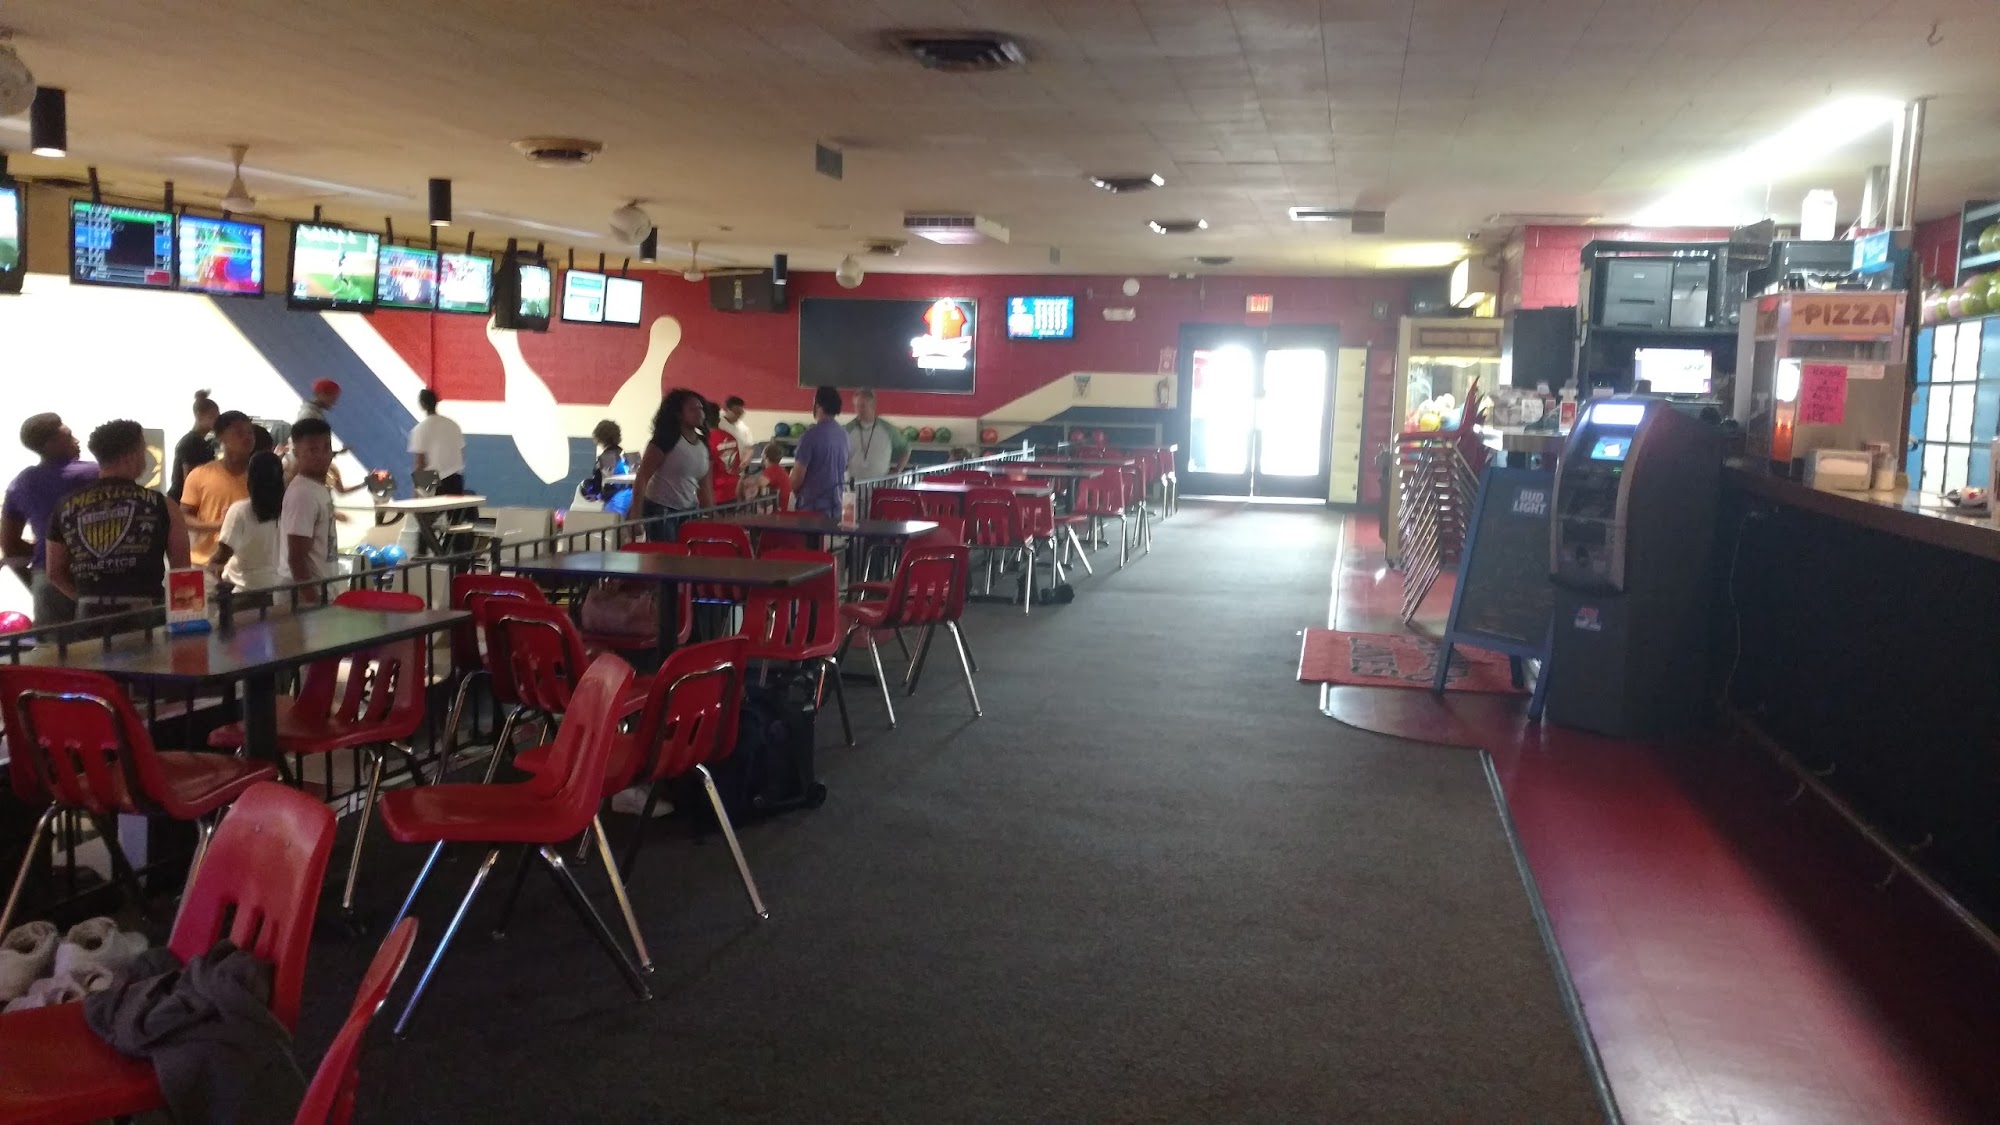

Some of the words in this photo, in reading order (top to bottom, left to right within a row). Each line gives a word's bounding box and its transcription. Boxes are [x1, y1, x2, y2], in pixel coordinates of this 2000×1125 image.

[1804, 303, 1891, 326] PIZZA
[1519, 490, 1545, 502] BUD
[1512, 500, 1547, 515] LIGHT
